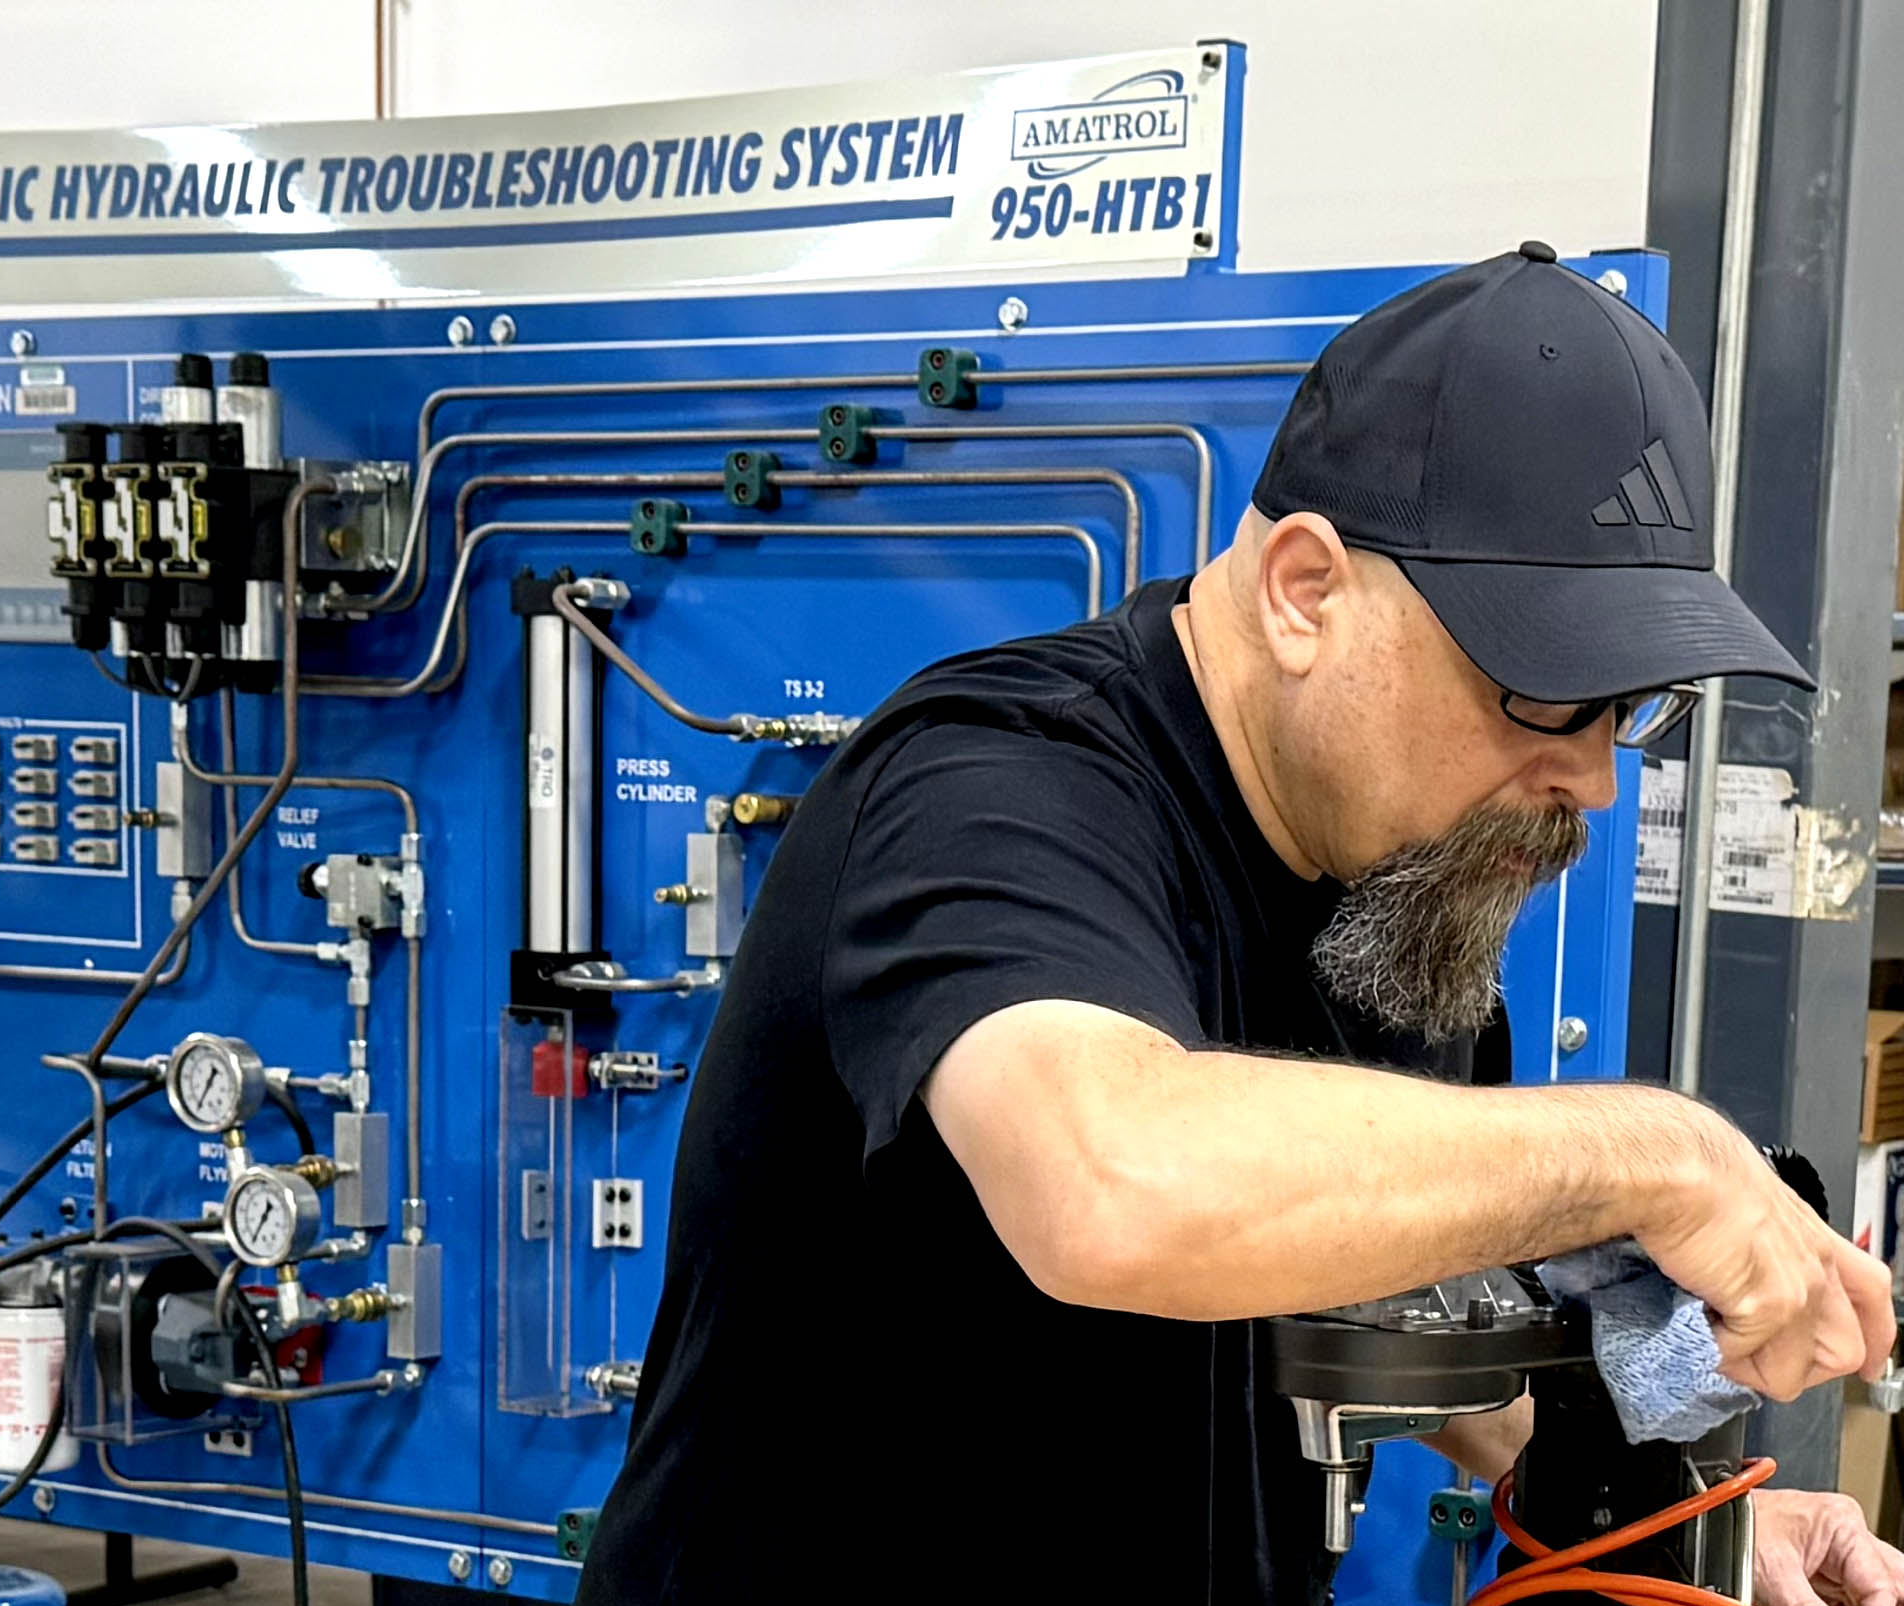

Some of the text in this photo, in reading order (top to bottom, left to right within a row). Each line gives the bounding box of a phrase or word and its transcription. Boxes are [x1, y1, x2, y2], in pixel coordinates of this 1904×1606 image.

[1021, 109, 1178, 148] AMATROL
[51, 156, 305, 222] HYDRAULIC
[318, 131, 762, 215] TROUBLESHOOTING
[773, 112, 965, 191] SYSTEM
[990, 172, 1212, 241] 950-HTB1
[783, 679, 802, 698] TS
[616, 758, 670, 777] PRESS
[616, 783, 697, 802] CYLINDER
[277, 831, 317, 849] VALVE
[66, 1160, 95, 1179] FILTE
